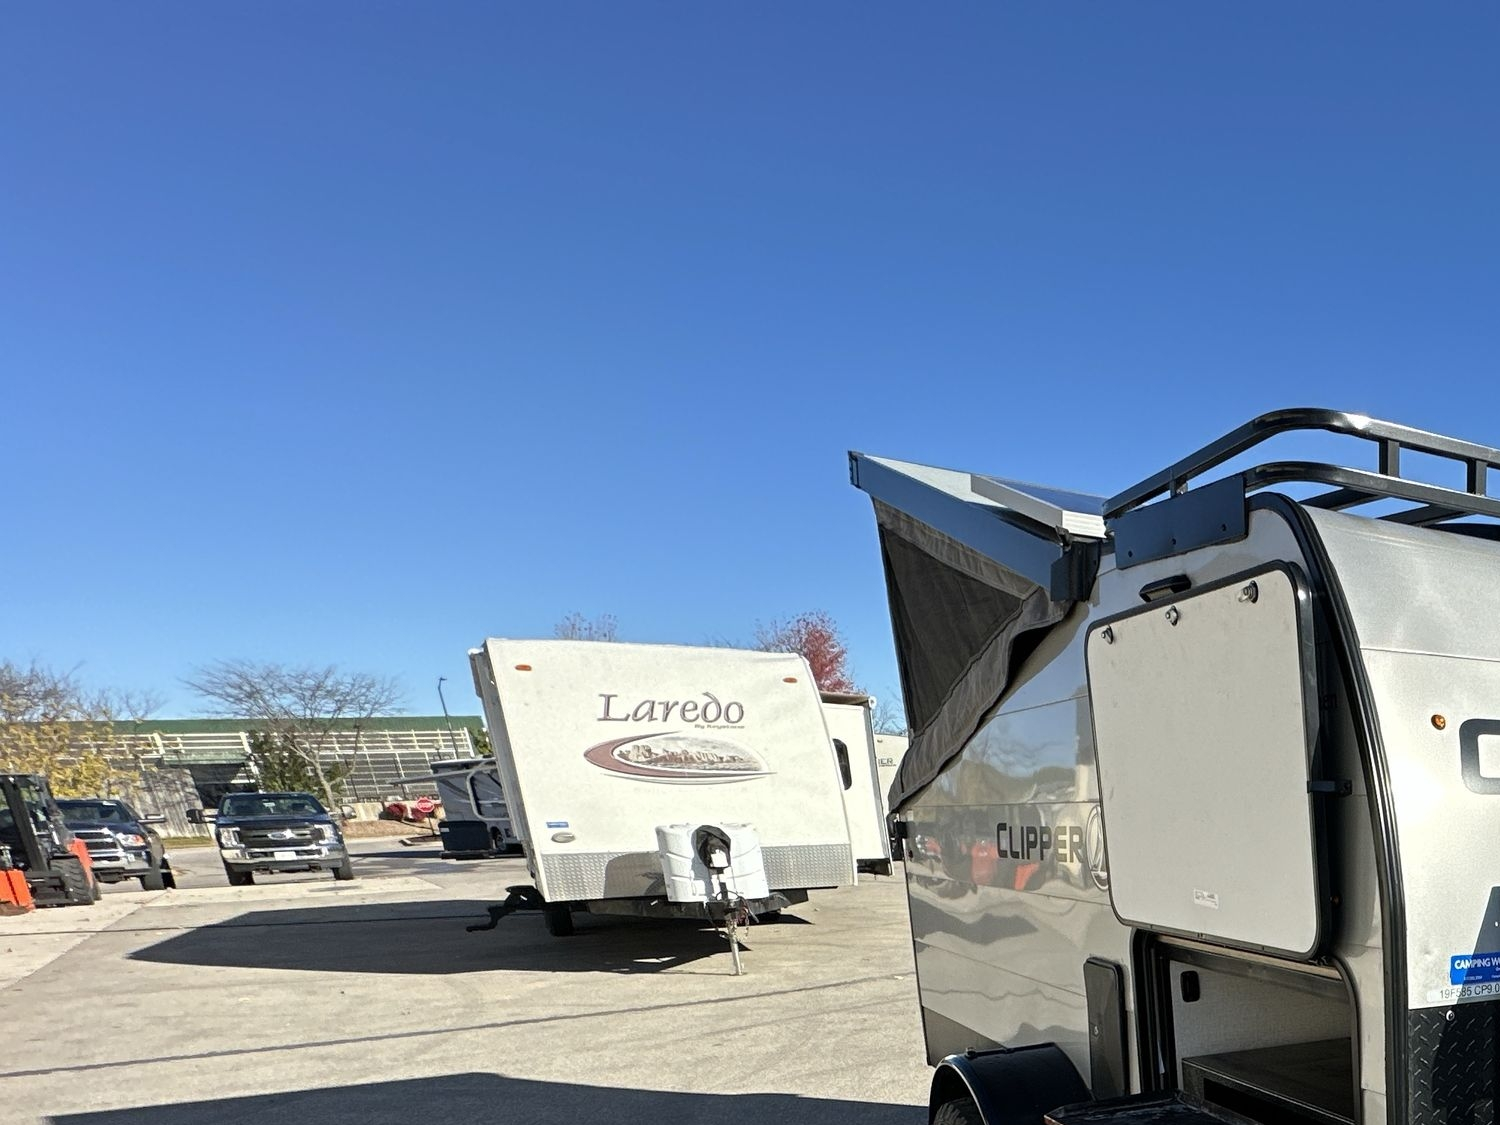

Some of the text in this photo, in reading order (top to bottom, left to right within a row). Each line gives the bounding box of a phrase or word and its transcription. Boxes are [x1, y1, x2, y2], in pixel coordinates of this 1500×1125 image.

[596, 691, 745, 724] Laredo
[996, 822, 1085, 864] CLIPPER
[1454, 957, 1491, 970] CAMPING
